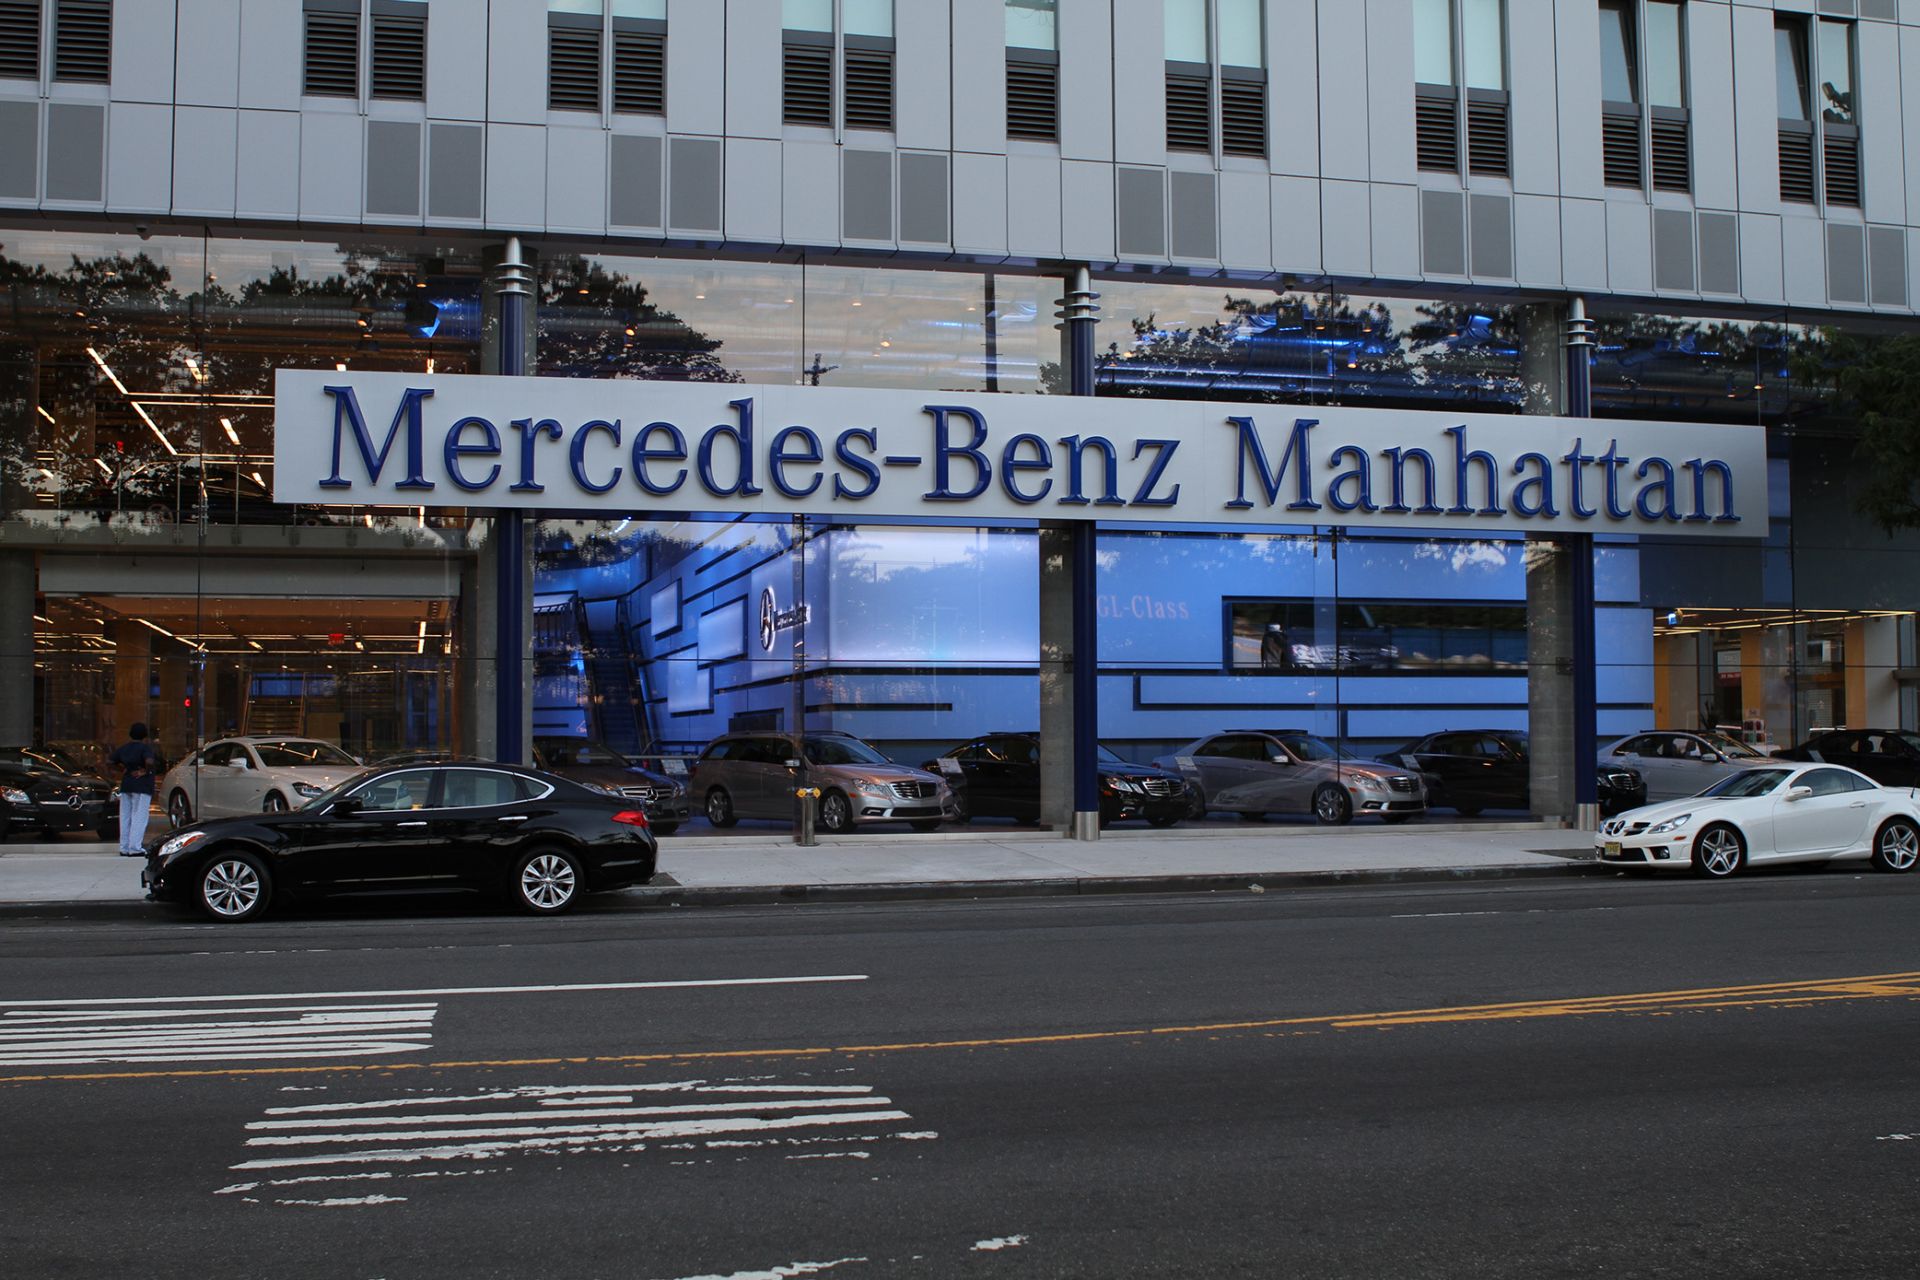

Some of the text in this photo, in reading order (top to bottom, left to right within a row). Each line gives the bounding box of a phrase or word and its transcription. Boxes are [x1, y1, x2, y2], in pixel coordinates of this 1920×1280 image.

[319, 385, 1741, 523] Mercedes-Benz Manhattan
[1097, 594, 1189, 619] GL-Class
